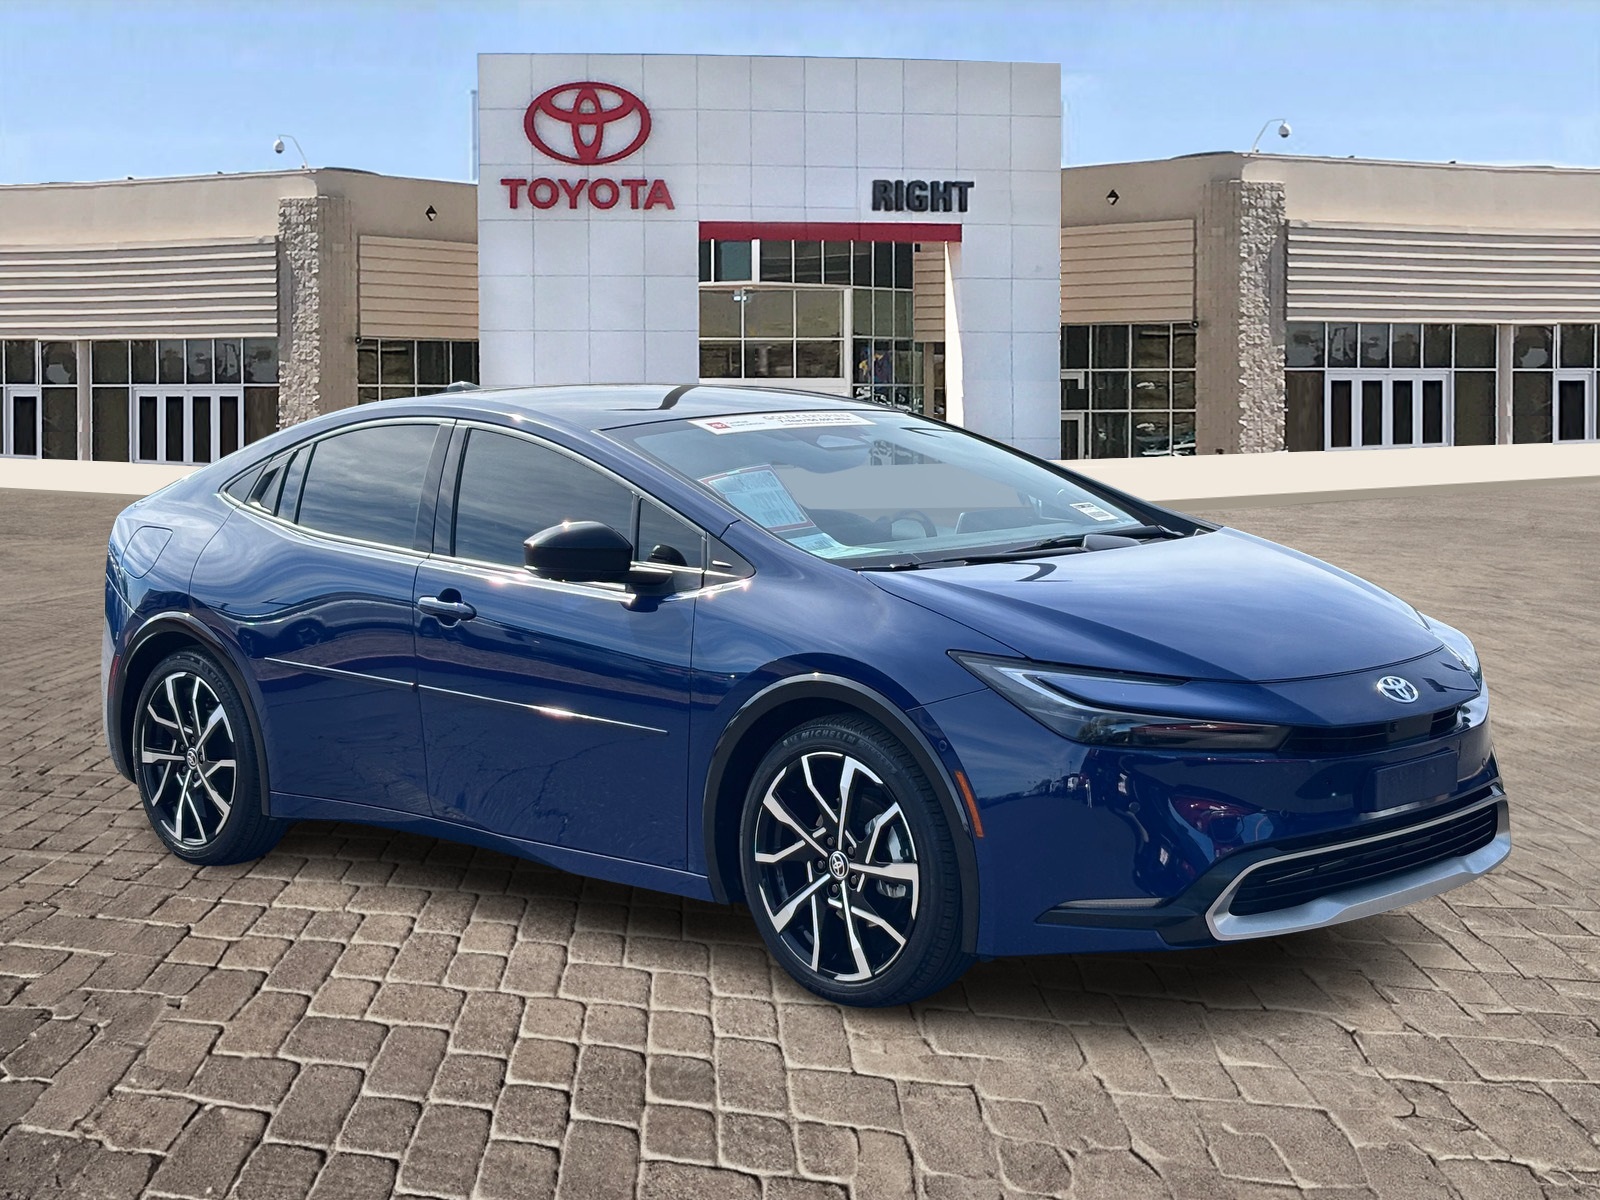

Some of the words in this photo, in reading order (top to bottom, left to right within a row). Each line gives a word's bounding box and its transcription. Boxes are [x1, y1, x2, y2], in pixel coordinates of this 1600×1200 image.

[500, 177, 675, 210] TOYOTA
[872, 179, 975, 212] RIGHT
[800, 729, 857, 744] MICHELIN
